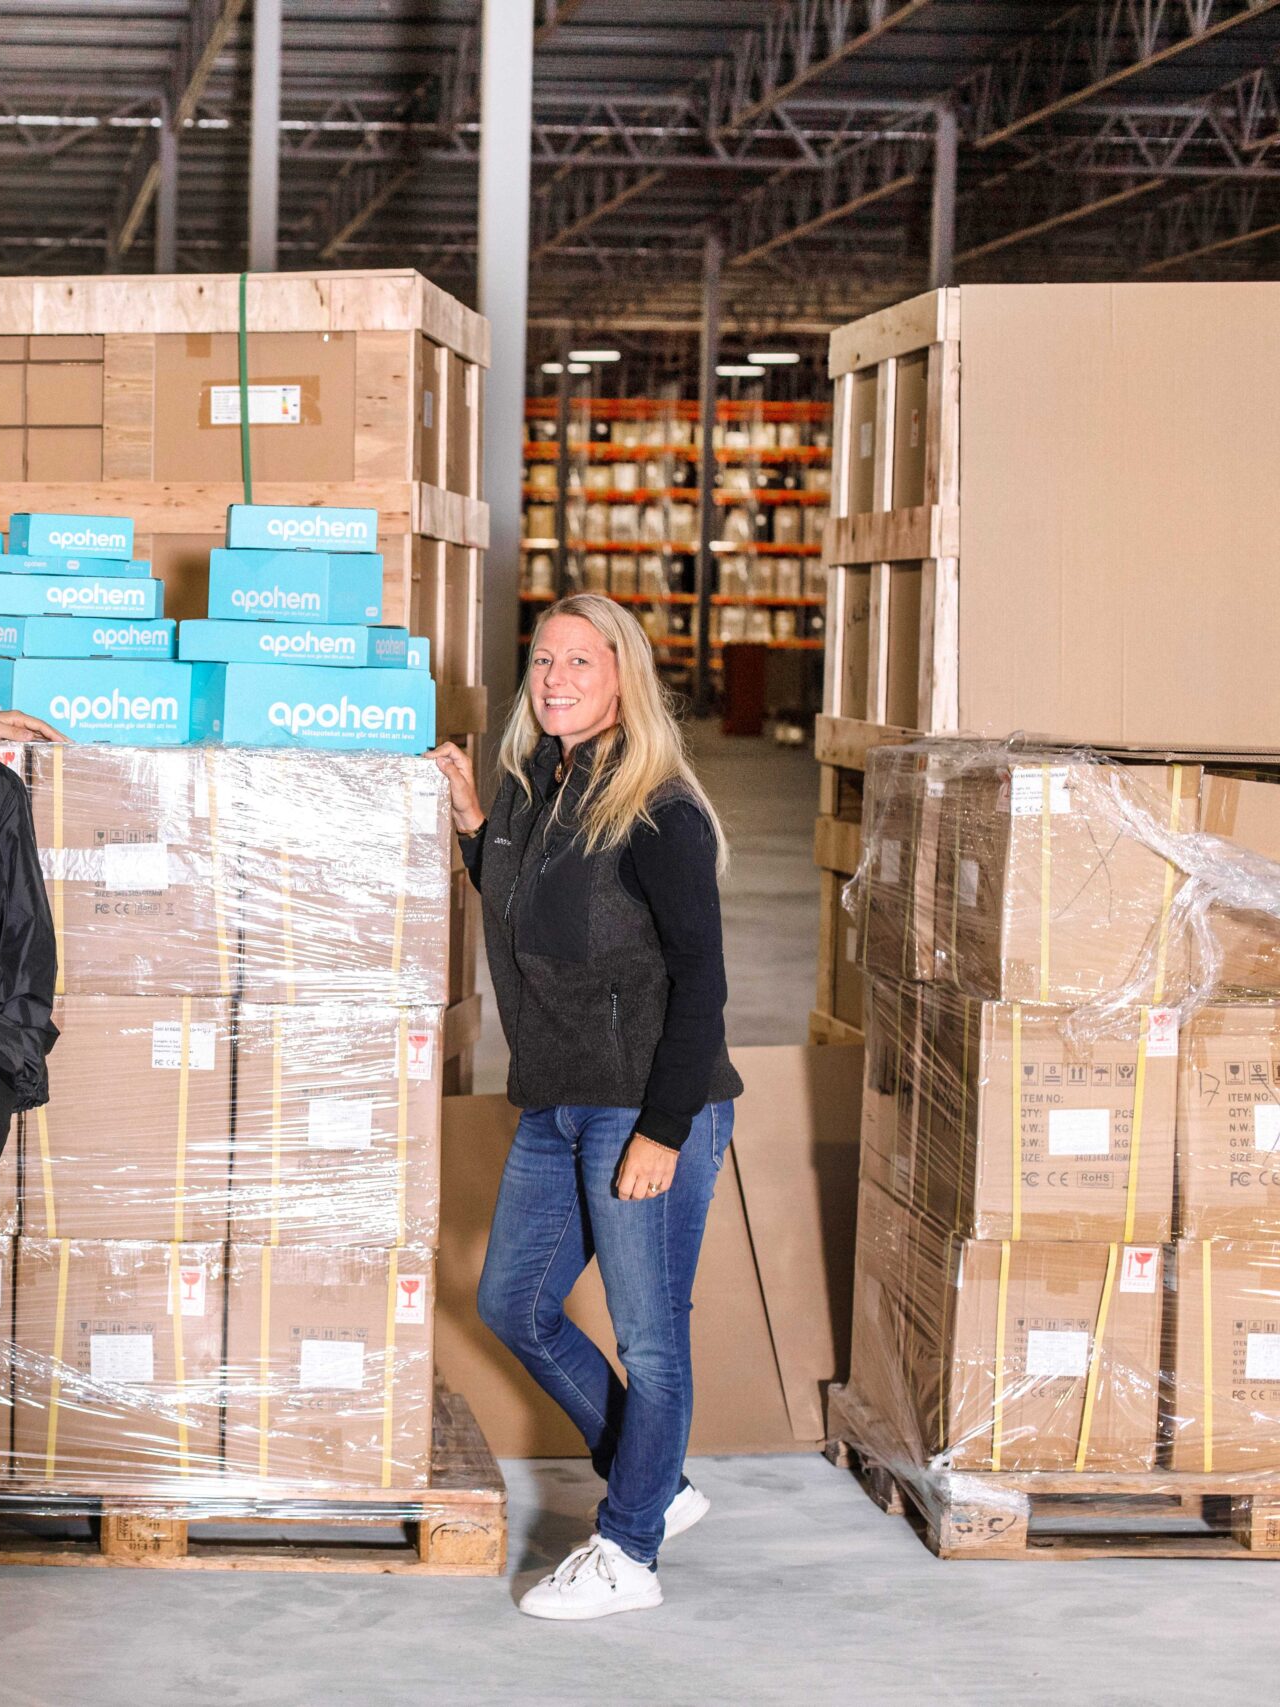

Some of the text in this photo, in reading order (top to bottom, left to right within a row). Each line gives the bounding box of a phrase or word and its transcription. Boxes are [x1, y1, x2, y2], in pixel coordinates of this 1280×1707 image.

[266, 515, 368, 542] apohem
[48, 528, 127, 549] apohem
[46, 582, 145, 609] apohem
[231, 585, 321, 613] apohem
[92, 625, 169, 650] apohem
[259, 631, 356, 657] apohem
[49, 687, 179, 729] apohem
[268, 695, 417, 735] apohem
[114, 903, 130, 915] CE
[1046, 1094, 1064, 1104] NO:
[1228, 1093, 1272, 1102] ITEM NO:
[1228, 1108, 1252, 1118] QTY:
[1114, 1124, 1129, 1133] KG
[1114, 1138, 1129, 1148] KG
[1047, 1171, 1069, 1187] CE
[1081, 1173, 1110, 1183] RoHS
[1250, 1390, 1265, 1401] CE
